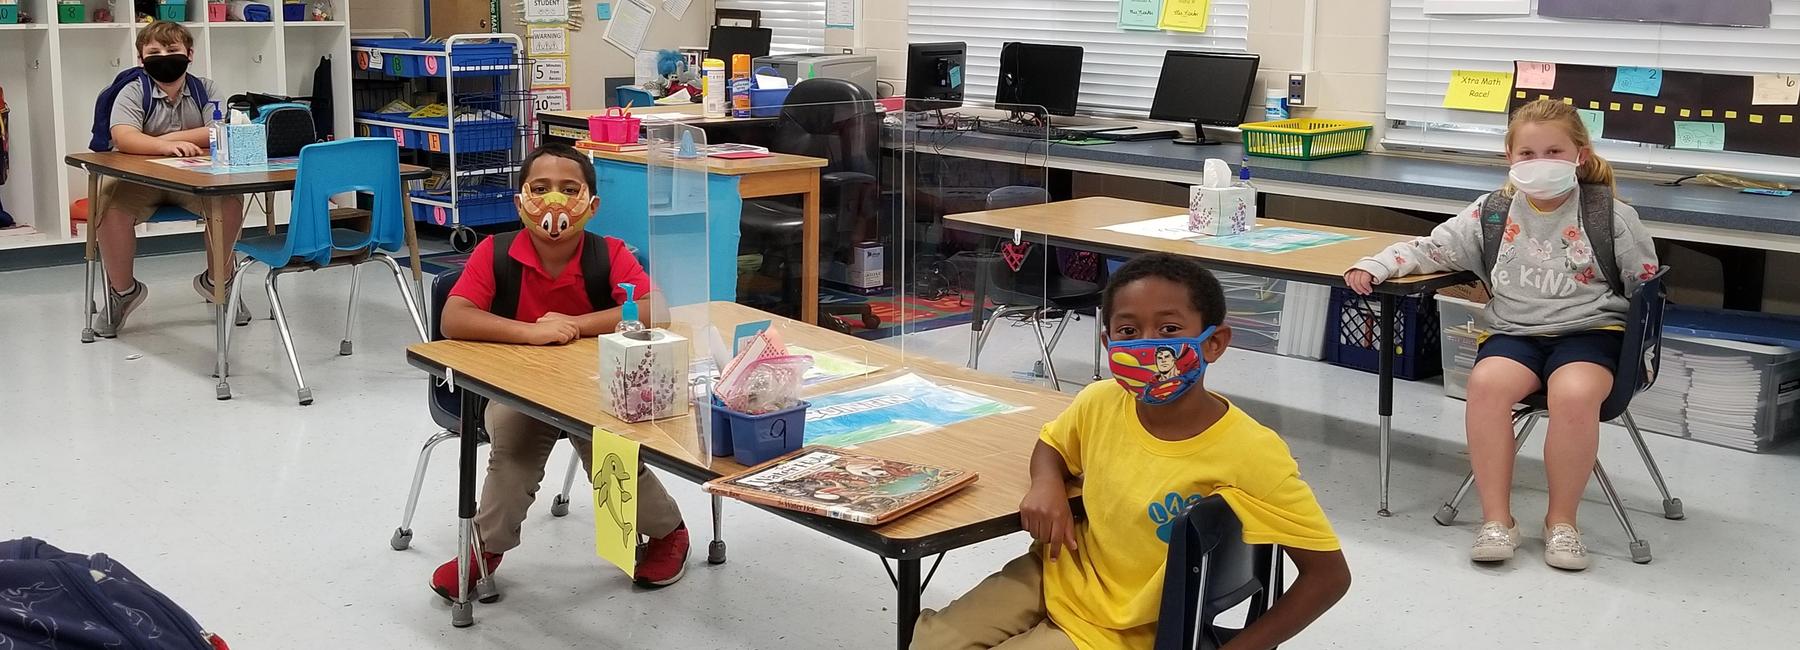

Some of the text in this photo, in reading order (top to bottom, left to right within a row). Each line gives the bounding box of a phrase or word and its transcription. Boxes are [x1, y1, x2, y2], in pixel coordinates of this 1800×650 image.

[536, 64, 544, 80] 5
[1648, 68, 1657, 80] 2
[1461, 76, 1502, 86] Xtra Math
[535, 99, 549, 111] 10
[770, 418, 787, 449] 9
